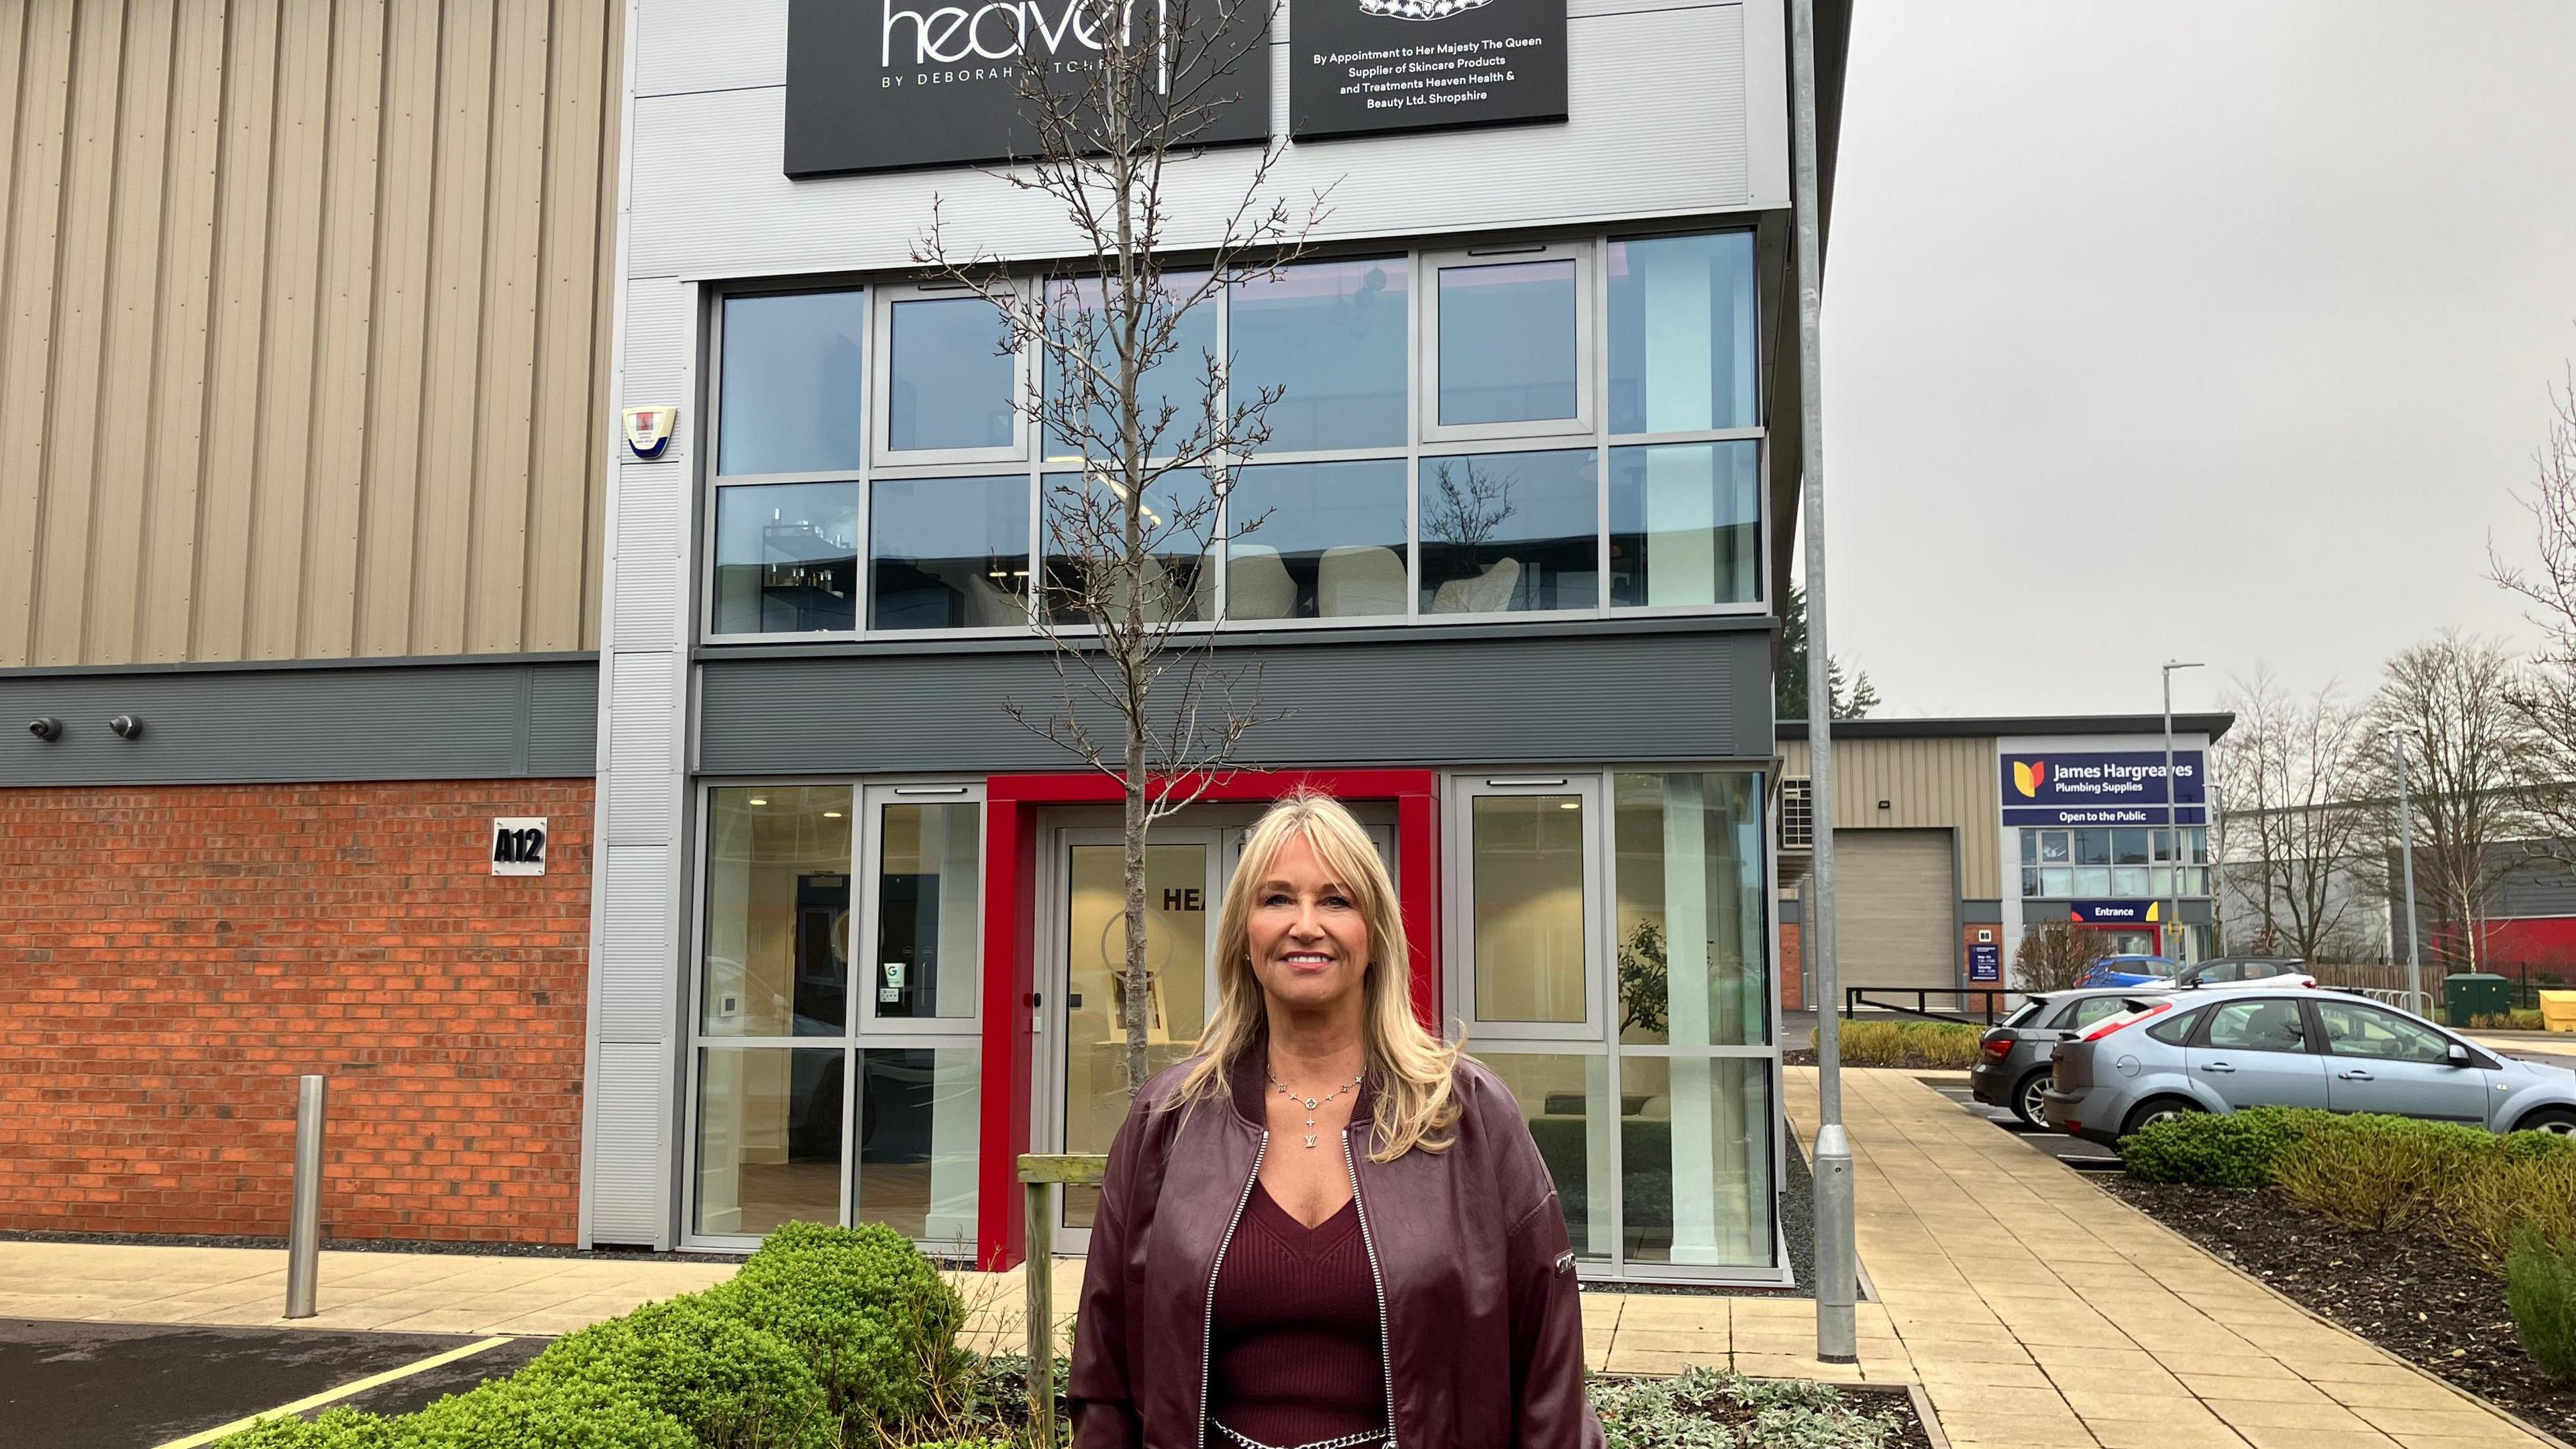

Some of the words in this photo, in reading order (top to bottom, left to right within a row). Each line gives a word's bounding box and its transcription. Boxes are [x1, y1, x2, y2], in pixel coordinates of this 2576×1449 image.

[1313, 54, 1327, 65] By
[1330, 48, 1399, 64] Appointment
[1402, 48, 1413, 57] to
[1415, 45, 1435, 56] Her
[1437, 42, 1479, 54] Majesty
[1481, 40, 1503, 50] The
[1505, 37, 1542, 48] Queen
[1348, 65, 1393, 78] Supplier
[1395, 63, 1407, 73] of
[1409, 61, 1454, 72] Skincare
[1457, 56, 1505, 68] Products
[882, 76, 903, 88] BY
[918, 68, 1012, 85] DEBORAH
[1340, 83, 1360, 95] and
[1362, 80, 1424, 93] Treatments
[1426, 76, 1466, 88] Heaven
[1468, 72, 1503, 83] Health
[1506, 71, 1515, 80] &
[1367, 97, 1403, 109] Beauty
[1406, 94, 1426, 105] Ltd.
[1429, 91, 1487, 104] Shropshire
[2053, 763, 2101, 782] James
[2055, 782, 2101, 794] Plumbing
[2102, 782, 2143, 793] Supplies
[2059, 811, 2085, 824] Open
[2087, 812, 2097, 821] to
[2098, 811, 2115, 821] the
[2116, 811, 2146, 821] Public
[494, 828, 541, 861] A12
[2095, 907, 2134, 916] Entrance
